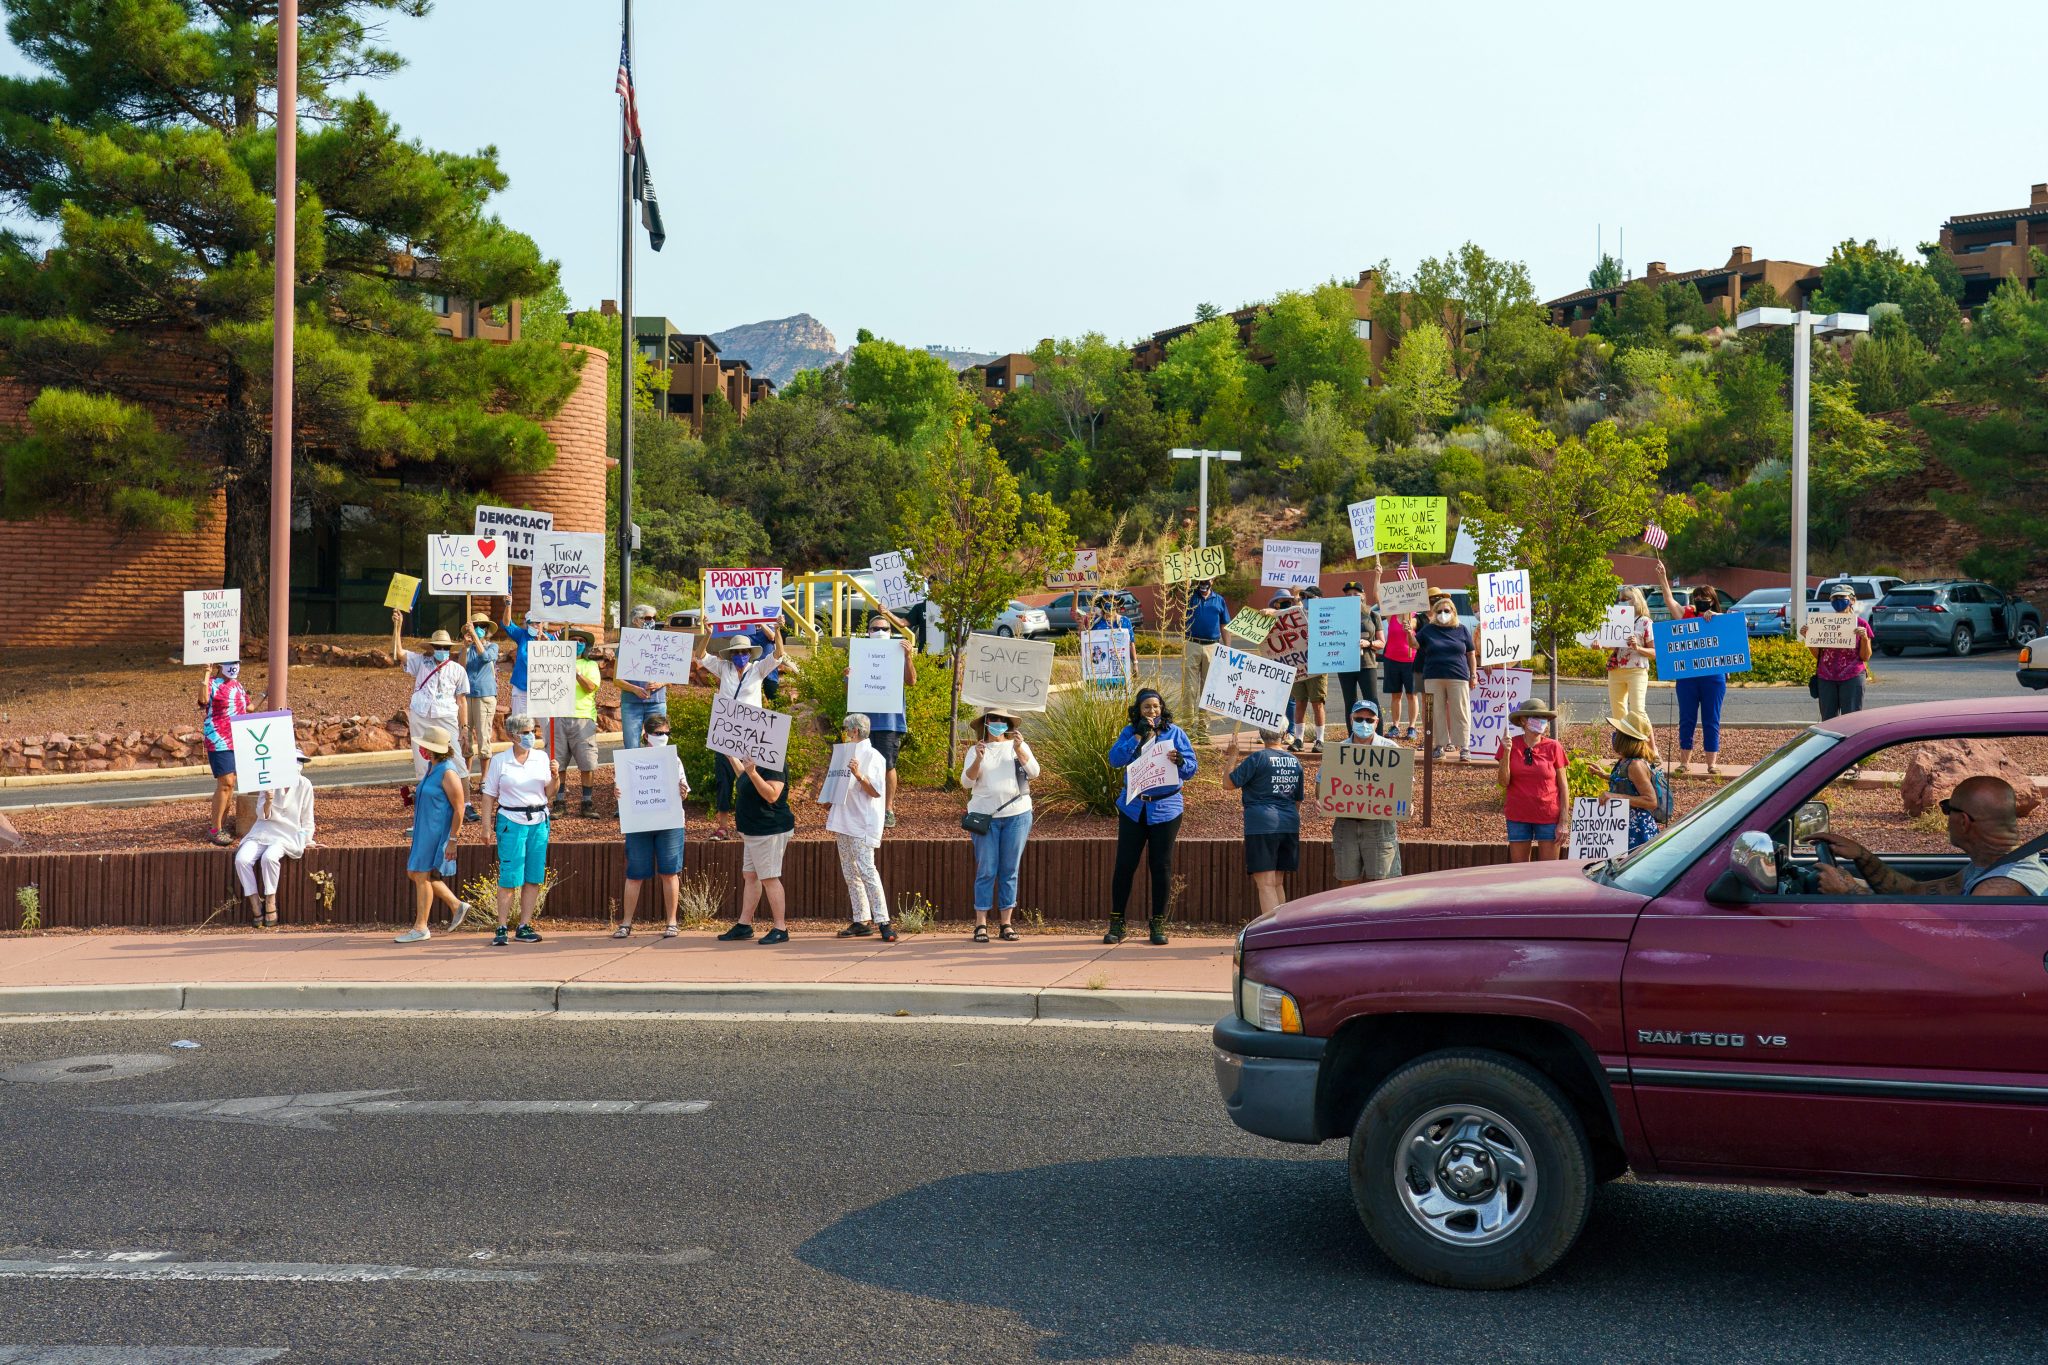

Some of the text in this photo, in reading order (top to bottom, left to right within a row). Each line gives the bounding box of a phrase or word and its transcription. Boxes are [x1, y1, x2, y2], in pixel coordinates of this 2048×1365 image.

[1381, 497, 1439, 510] Do Not Let
[479, 511, 551, 531] DEMOCRACY
[1384, 513, 1405, 524] ANY
[1412, 510, 1435, 523] ONE
[1386, 524, 1437, 537] TAKE AWAY
[438, 537, 470, 557] We
[550, 543, 582, 561] TURN
[1266, 544, 1320, 556] DUMP TRUMP
[1377, 542, 1436, 551] DEMOCRACY
[440, 560, 500, 573] the Post
[538, 562, 591, 579] ARIZONA
[1173, 561, 1222, 581] DJOY
[1278, 559, 1300, 569] NOT
[442, 572, 492, 586] Office
[1050, 573, 1064, 583] NOT
[1066, 572, 1086, 582] YOUR
[1267, 572, 1316, 584] THE MAIL
[1489, 571, 1523, 597] Fund
[203, 591, 224, 601] DON'T
[540, 580, 597, 609] BLUE
[715, 585, 771, 601] VOTE BY
[1383, 584, 1404, 597] YOUR
[1407, 582, 1425, 591] VOTE
[201, 602, 228, 610] TOUCH
[1497, 593, 1525, 612] Mail
[193, 608, 239, 620] MY DEMOCRACY
[721, 603, 760, 617] MAIL
[203, 620, 225, 629] DON'T
[1237, 607, 1276, 631] SAVE OUR
[1489, 613, 1520, 630] defund
[1810, 617, 1827, 625] SAVE
[1834, 617, 1851, 625] USPS
[202, 629, 229, 638] TOUCH
[1671, 622, 1699, 636] WE'LL
[638, 633, 678, 644] MAKE
[1667, 636, 1719, 653] REMEMBER
[533, 645, 573, 658] UPHOLD
[651, 644, 669, 652] THE
[980, 645, 1030, 666] SAVE
[530, 664, 571, 673] DEMOCRACY
[1229, 651, 1248, 670] WE
[1245, 660, 1257, 673] the
[1258, 664, 1294, 685] PEOPLE
[1674, 654, 1745, 672] IN NOVEMBER
[550, 676, 564, 691] OUT
[969, 669, 1044, 698] THE USPS
[1227, 672, 1243, 683] NOT
[714, 698, 777, 729] SUPPORT
[1206, 693, 1283, 728] then the PEOPLE
[1493, 703, 1505, 713] of
[713, 718, 773, 745] POSTAL
[246, 723, 271, 784] VOTE
[712, 733, 779, 764] WORKERS
[1270, 757, 1298, 767] TRUMP
[1340, 745, 1401, 768] FUND
[1271, 775, 1300, 783] PRISON
[1354, 769, 1380, 782] the
[1330, 777, 1394, 798] Postal
[1578, 798, 1622, 818] STOP
[1572, 818, 1627, 832] DESTROYING
[1576, 832, 1614, 846] AMERICA
[1579, 847, 1608, 860] FUND
[1638, 1030, 1681, 1044] RAM
[1690, 1033, 1745, 1047] 1500
